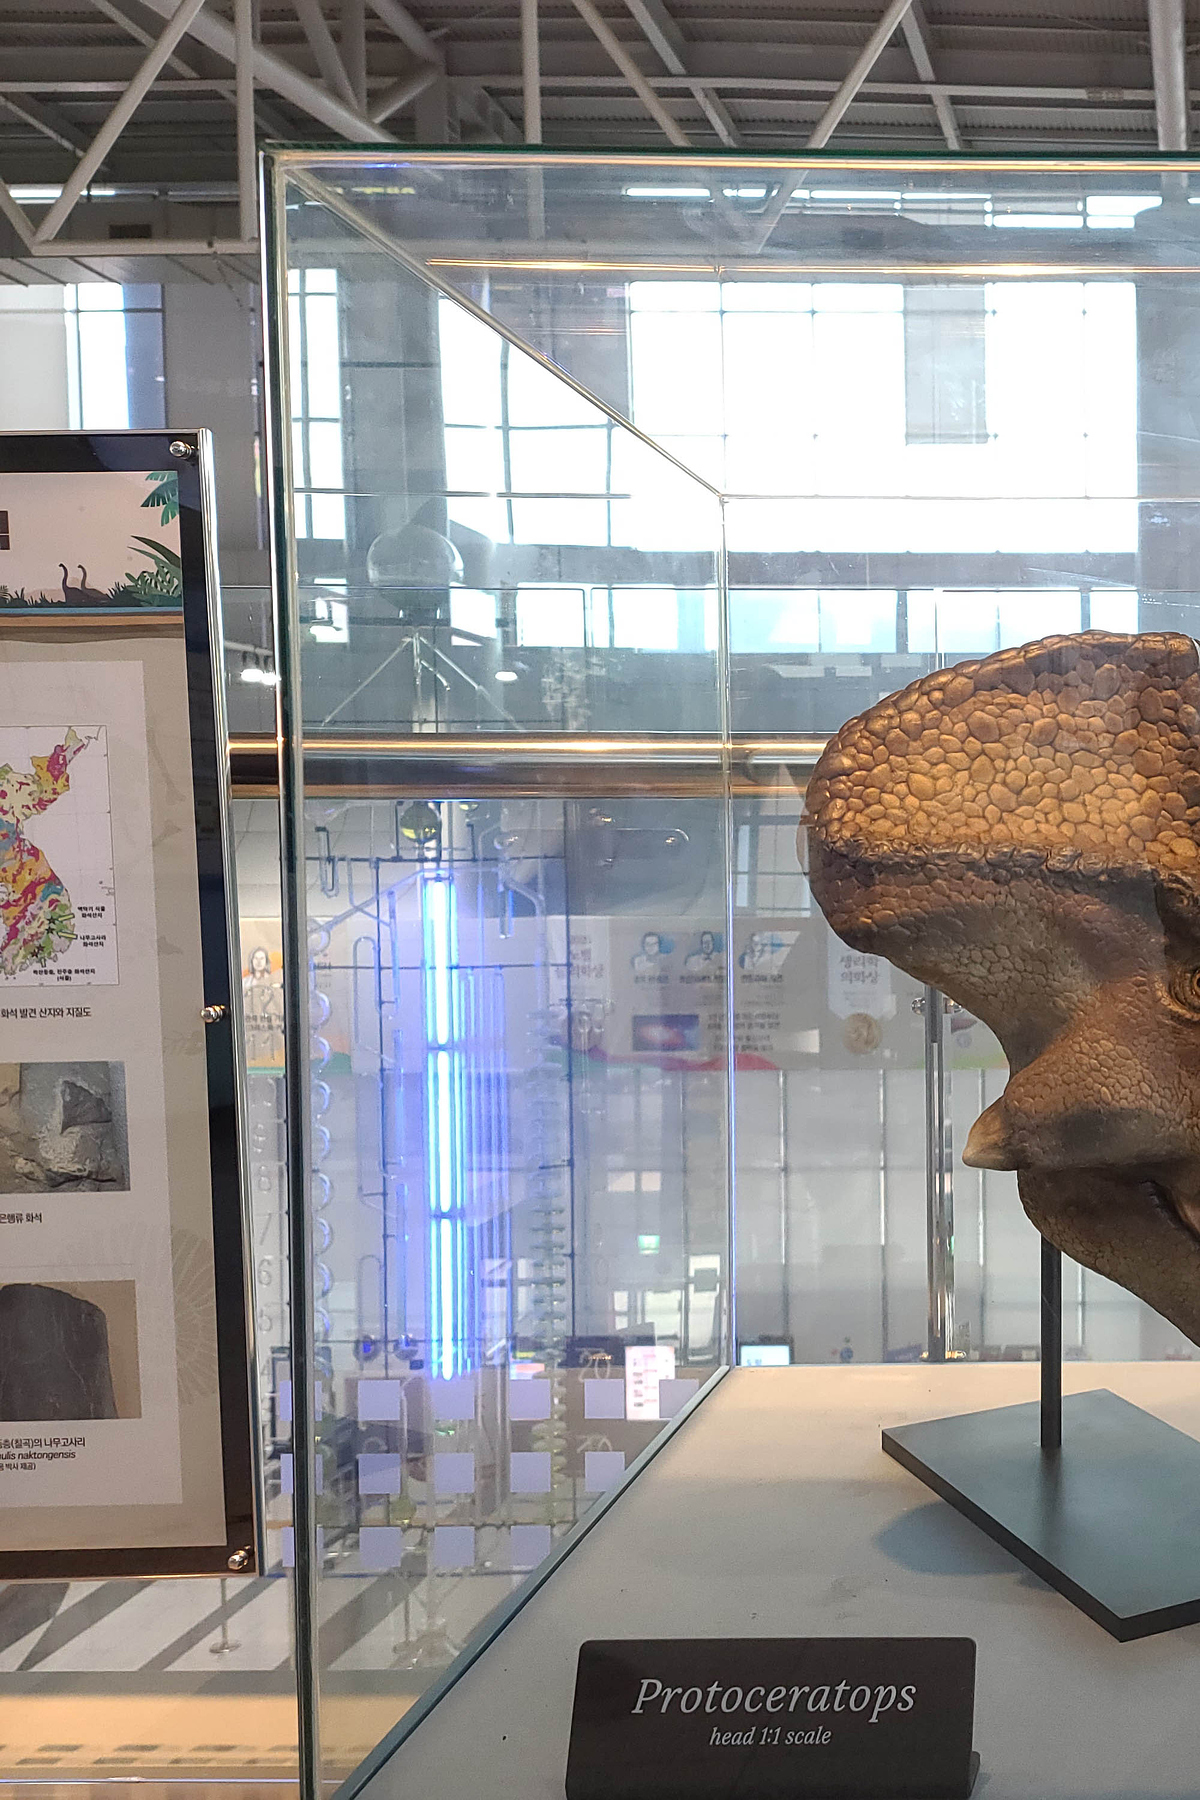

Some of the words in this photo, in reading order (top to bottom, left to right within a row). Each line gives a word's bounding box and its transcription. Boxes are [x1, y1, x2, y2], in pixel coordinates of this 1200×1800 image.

[0, 1007, 18, 1019] 화석
[19, 1007, 37, 1019] 발견
[39, 1007, 64, 1018] 산지와
[66, 1006, 92, 1018] 지질도
[25, 1212, 43, 1223] 화석
[44, 1436, 86, 1448] 나무고사리
[0, 1450, 16, 1460] ulis
[17, 1449, 76, 1461] naktongensis
[5, 1462, 19, 1471] 박사
[20, 1462, 37, 1471] 제공)
[631, 1678, 917, 1724] Protoceratops
[709, 1726, 754, 1746] head
[760, 1727, 781, 1746] 1:1
[785, 1726, 832, 1745] scale
